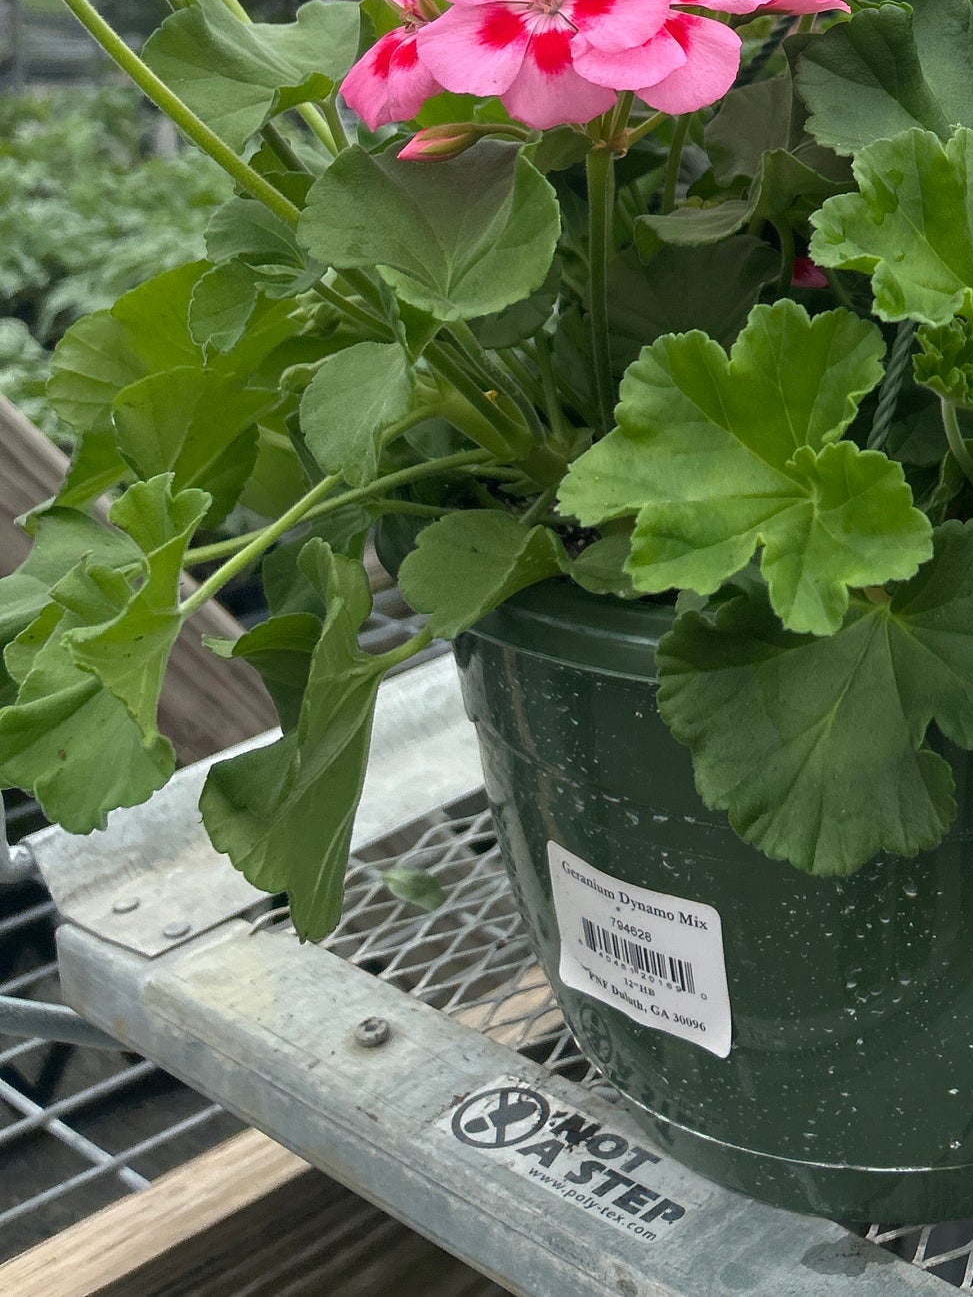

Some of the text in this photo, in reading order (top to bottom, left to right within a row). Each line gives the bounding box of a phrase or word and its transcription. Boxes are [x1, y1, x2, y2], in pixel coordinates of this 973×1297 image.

[562, 861, 708, 930] Geranium Dynamo Mix
[611, 917, 652, 942] 794628
[611, 985, 648, 1013] Duluth,
[650, 1004, 669, 1020] GA
[673, 1013, 706, 1032] 30096
[549, 1111, 661, 1174] NOT
[516, 1140, 686, 1225] A STEP
[528, 1166, 657, 1241] www.poly-tex.com
